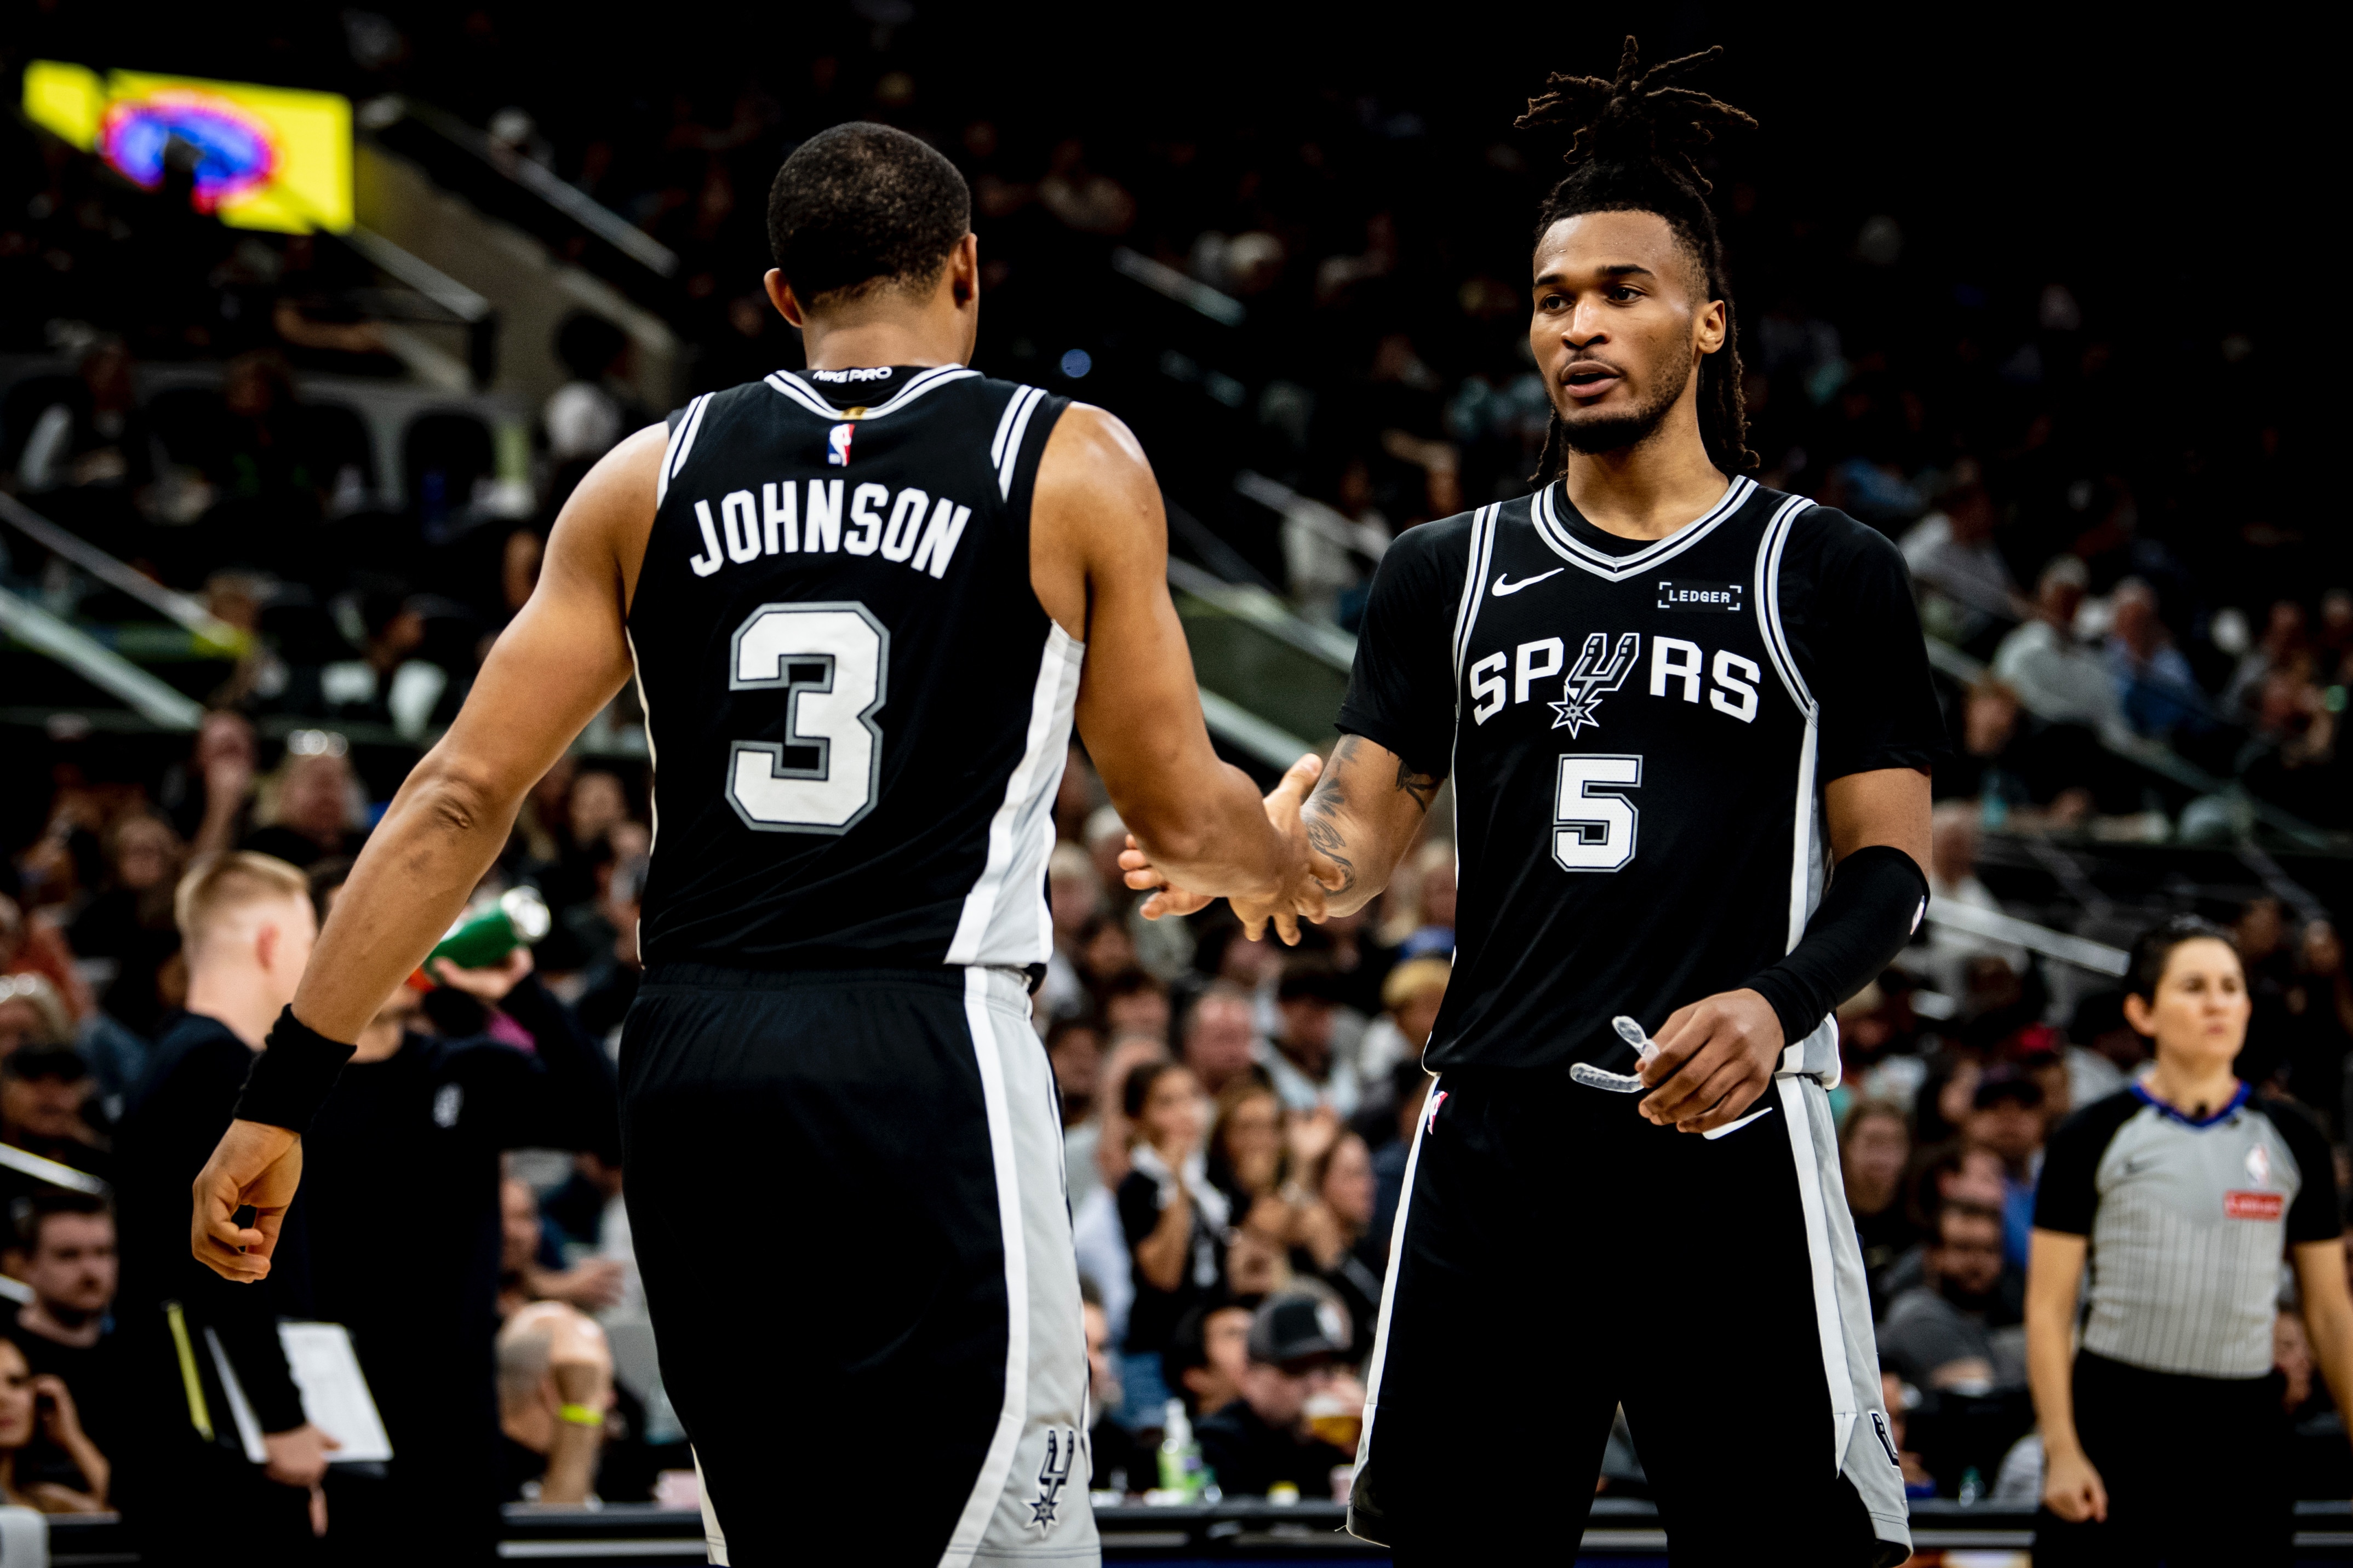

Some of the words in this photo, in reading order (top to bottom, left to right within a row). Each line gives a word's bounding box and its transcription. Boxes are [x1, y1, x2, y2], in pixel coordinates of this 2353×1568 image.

[848, 366, 892, 382] PRO
[690, 479, 972, 579] JOHNSON
[1669, 590, 1731, 603] LEDGER
[725, 601, 891, 836] 3
[1469, 632, 1761, 740] SPURS
[1552, 754, 1643, 873] 5
